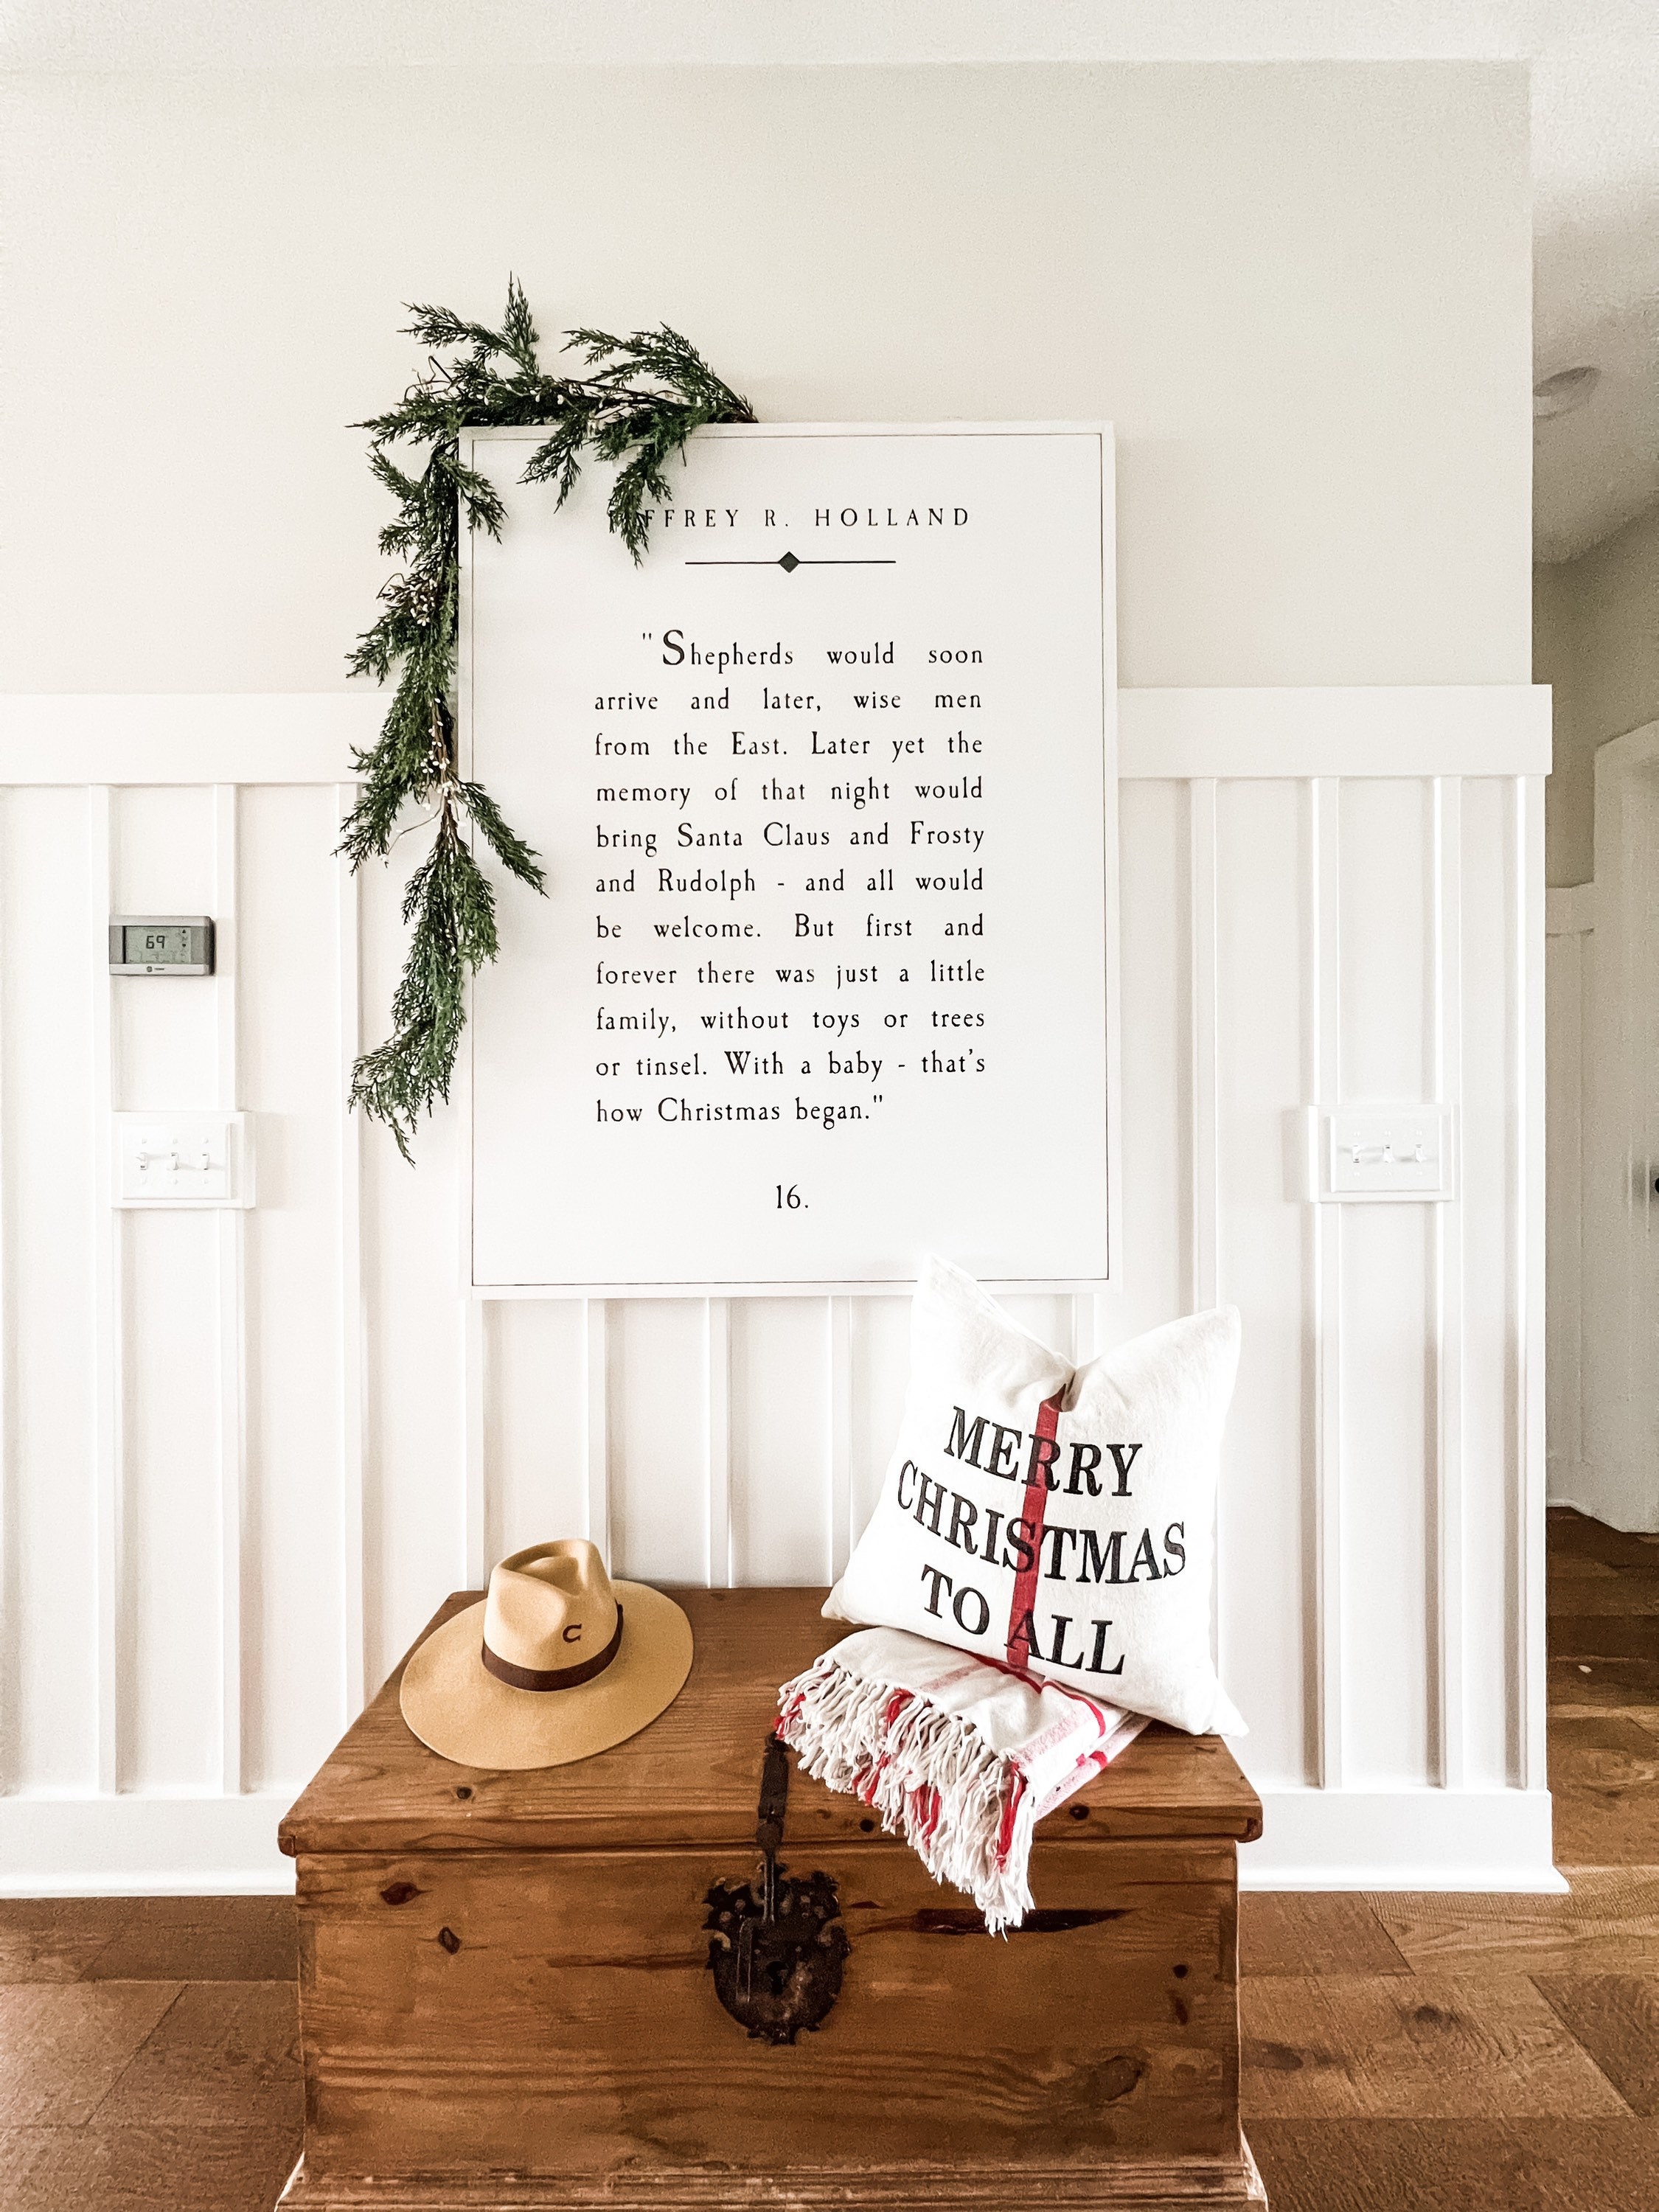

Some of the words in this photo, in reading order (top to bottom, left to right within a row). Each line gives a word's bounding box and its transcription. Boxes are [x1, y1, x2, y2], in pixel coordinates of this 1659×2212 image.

[644, 509, 739, 527] FFREY
[765, 509, 789, 527] R.
[815, 507, 969, 526] HOLLAND
[642, 629, 793, 675] "Shepherds
[827, 641, 894, 664] would
[928, 650, 983, 664] soon
[594, 692, 658, 710] arrive
[690, 686, 729, 710] and
[763, 686, 821, 712] later,
[853, 691, 901, 709] wise
[935, 695, 981, 709] men
[595, 732, 650, 756] from
[674, 732, 708, 755] the
[731, 731, 787, 755] East.
[811, 731, 871, 755] Later
[891, 737, 925, 763] yet
[947, 730, 982, 754] the
[597, 787, 691, 810] memory
[714, 777, 738, 801] of
[762, 777, 805, 800] that
[831, 776, 890, 810] night
[914, 775, 982, 799] would
[596, 824, 657, 858] bring
[678, 822, 742, 847] Santa
[763, 821, 830, 846] Claus
[849, 821, 888, 845] and
[911, 820, 984, 853] Frosty
[596, 869, 635, 892] and
[658, 868, 755, 901] Rudolph
[805, 868, 844, 891] and
[866, 869, 894, 891] all
[915, 867, 983, 891] would
[145, 935, 165, 950] 69
[596, 914, 622, 939] be
[653, 915, 761, 938] welcome.
[795, 913, 834, 937] But
[866, 913, 912, 937] first
[945, 912, 984, 936] and
[597, 961, 677, 984] forever
[697, 960, 755, 984] there
[775, 969, 815, 983] was
[837, 964, 878, 990] just
[899, 968, 909, 982] a
[931, 959, 984, 982] little
[597, 1006, 676, 1039] family,
[700, 1006, 789, 1029] without
[813, 1012, 860, 1037] toys
[884, 1014, 908, 1028] or
[931, 1010, 984, 1027] trees
[596, 1062, 620, 1077] or
[636, 1052, 707, 1076] tinsel.
[723, 1051, 784, 1075] With
[801, 1060, 811, 1074] a
[827, 1050, 883, 1082] baby
[921, 1048, 985, 1074] that's
[597, 1099, 643, 1122] how
[658, 1096, 780, 1121] Christmas
[795, 1094, 883, 1130] began."
[776, 1184, 809, 1209] 16.
[943, 1405, 1143, 1497] MERRY
[897, 1459, 1186, 1585] CHRISTMAS
[920, 1564, 990, 1635] TO
[1004, 1609, 1125, 1675] ALL
